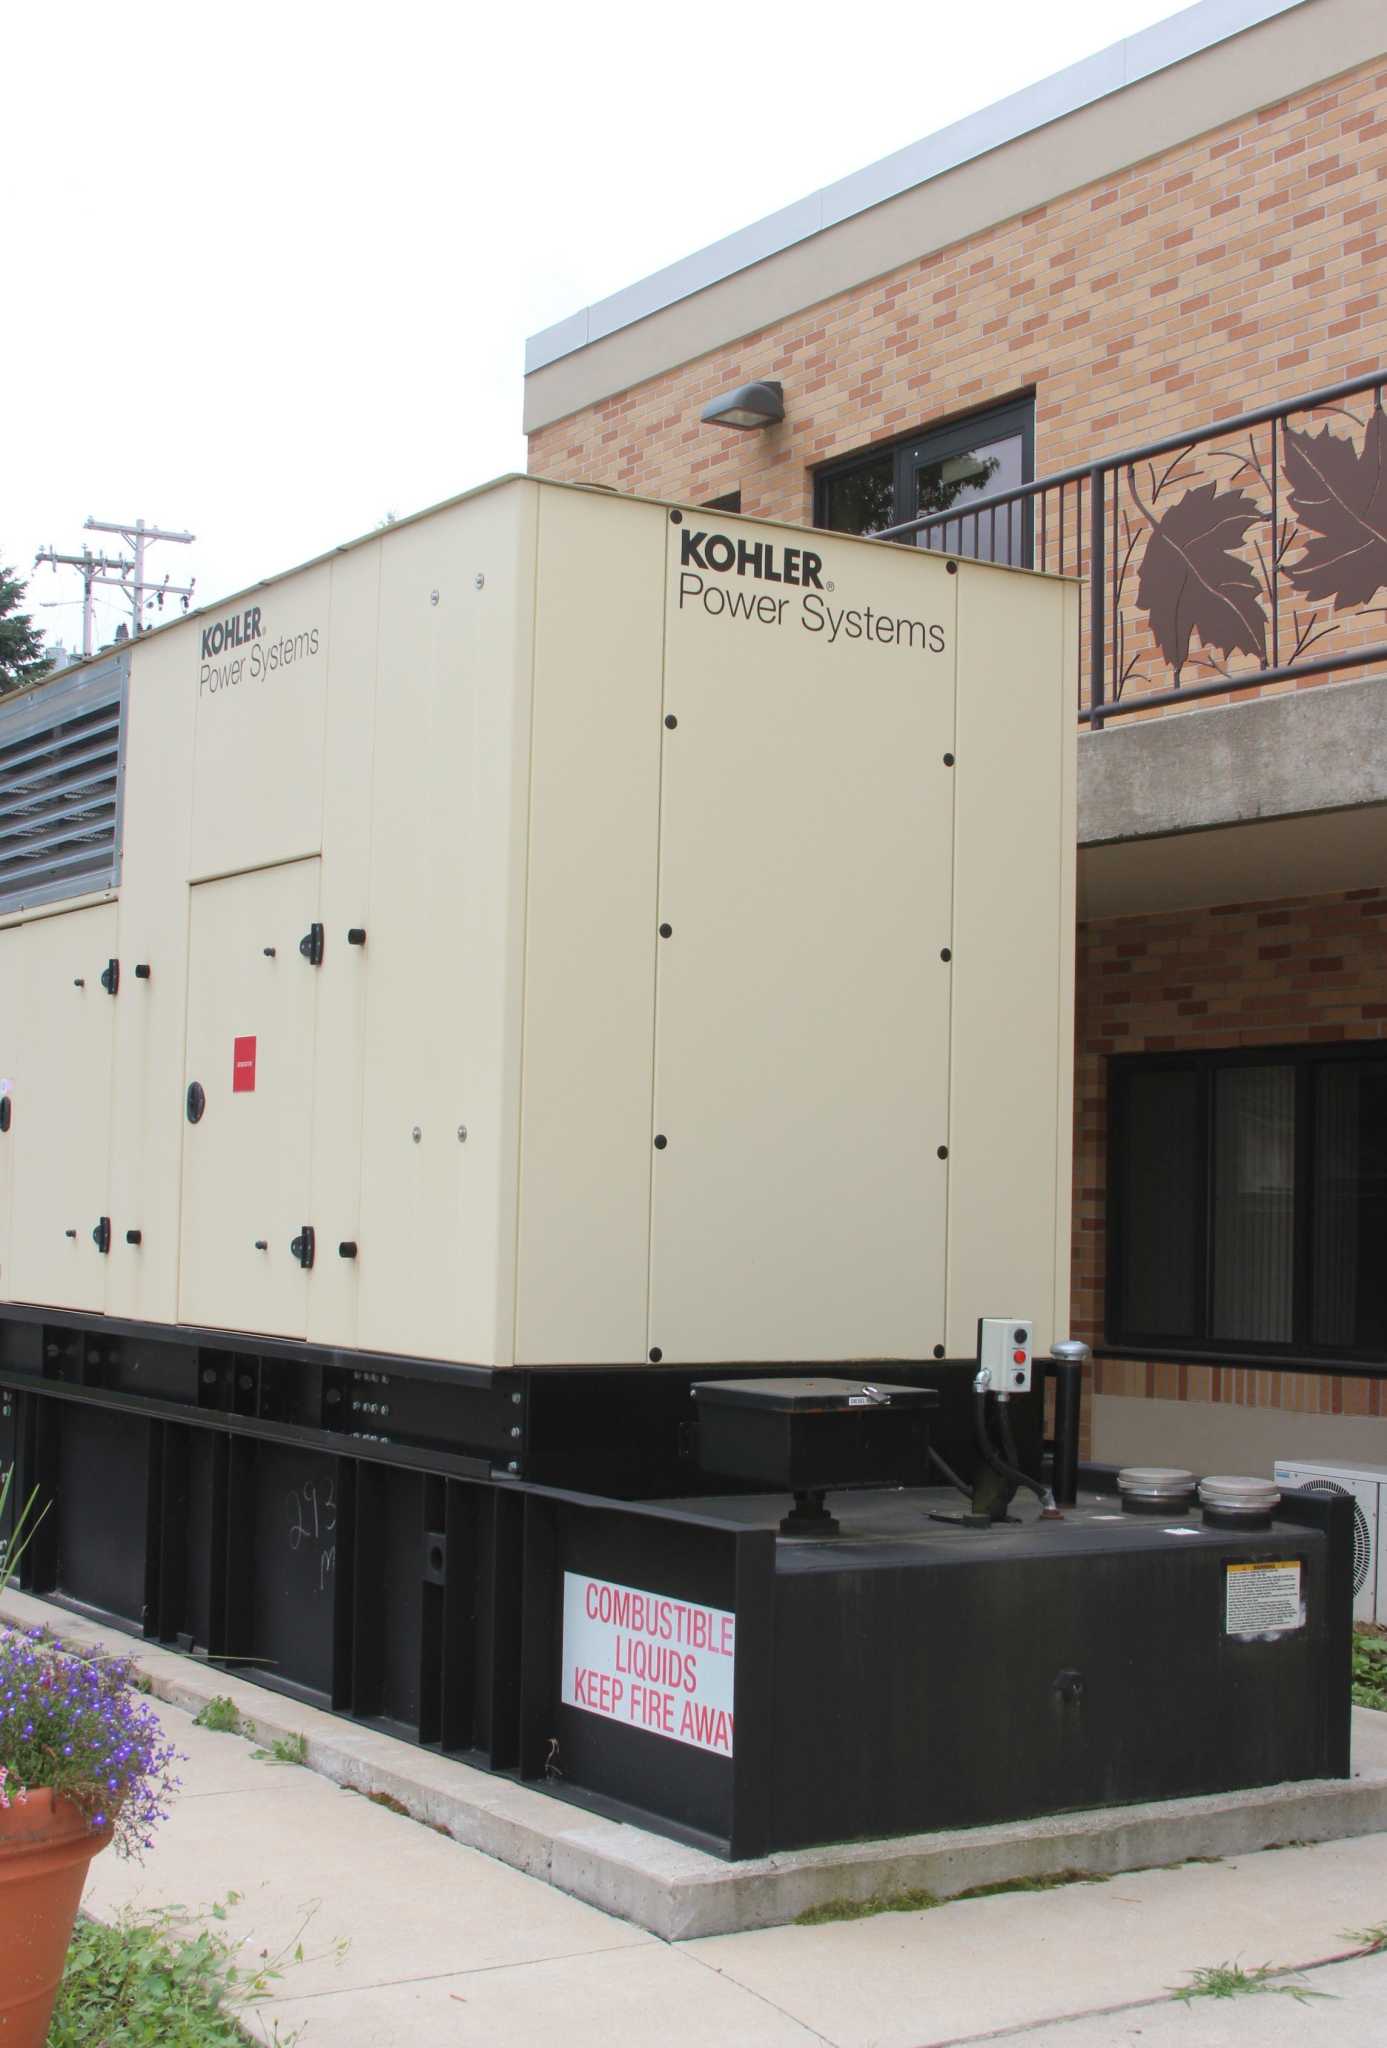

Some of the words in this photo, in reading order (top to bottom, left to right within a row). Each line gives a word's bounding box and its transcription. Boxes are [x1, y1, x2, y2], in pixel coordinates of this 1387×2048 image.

[682, 529, 824, 590] KOHLER
[201, 606, 262, 660] KOHLER
[679, 572, 789, 625] Power
[801, 594, 945, 653] Systems
[200, 657, 246, 697] Power
[250, 628, 319, 682] Systems
[586, 1582, 734, 1657] COMBUSTIBLE
[615, 1635, 697, 1693] LIQUIDS
[575, 1666, 624, 1714] KEEP
[630, 1683, 675, 1732] FIRE
